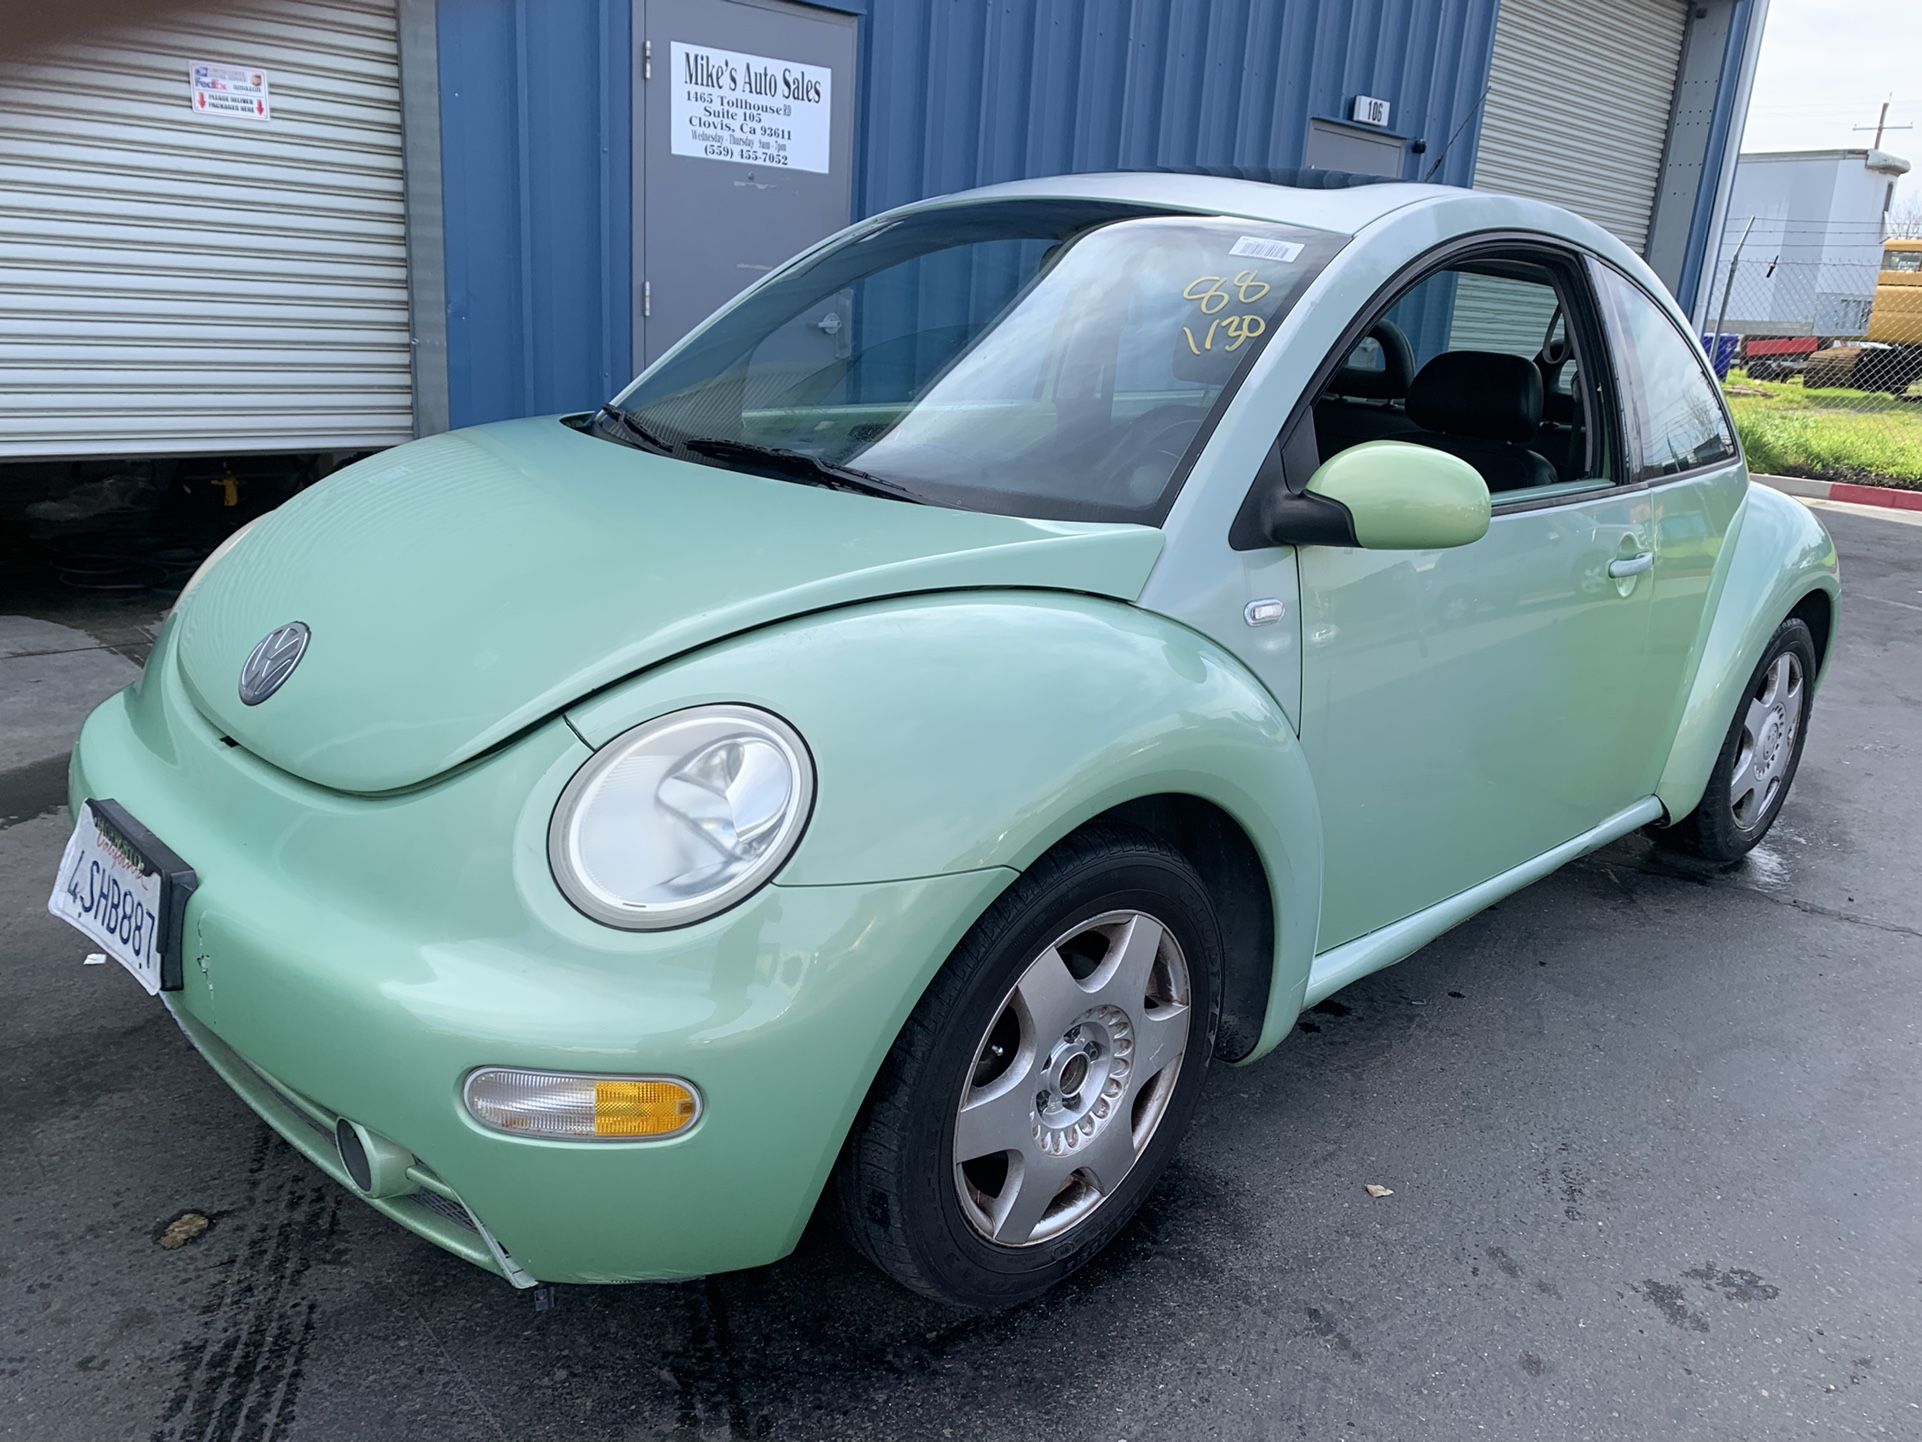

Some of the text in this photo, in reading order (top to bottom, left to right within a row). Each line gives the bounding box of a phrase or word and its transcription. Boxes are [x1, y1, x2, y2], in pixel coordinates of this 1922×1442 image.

[684, 52, 821, 103] Mike's Auto Sales
[686, 90, 713, 104] 1465
[717, 94, 782, 116] Tollhouse
[703, 106, 762, 123] Suite 105
[1368, 100, 1384, 122] 106
[689, 115, 792, 140] Clovis, Ca 93611
[704, 144, 789, 166] (559) 455-7052
[67, 850, 156, 969] 4SHB887
